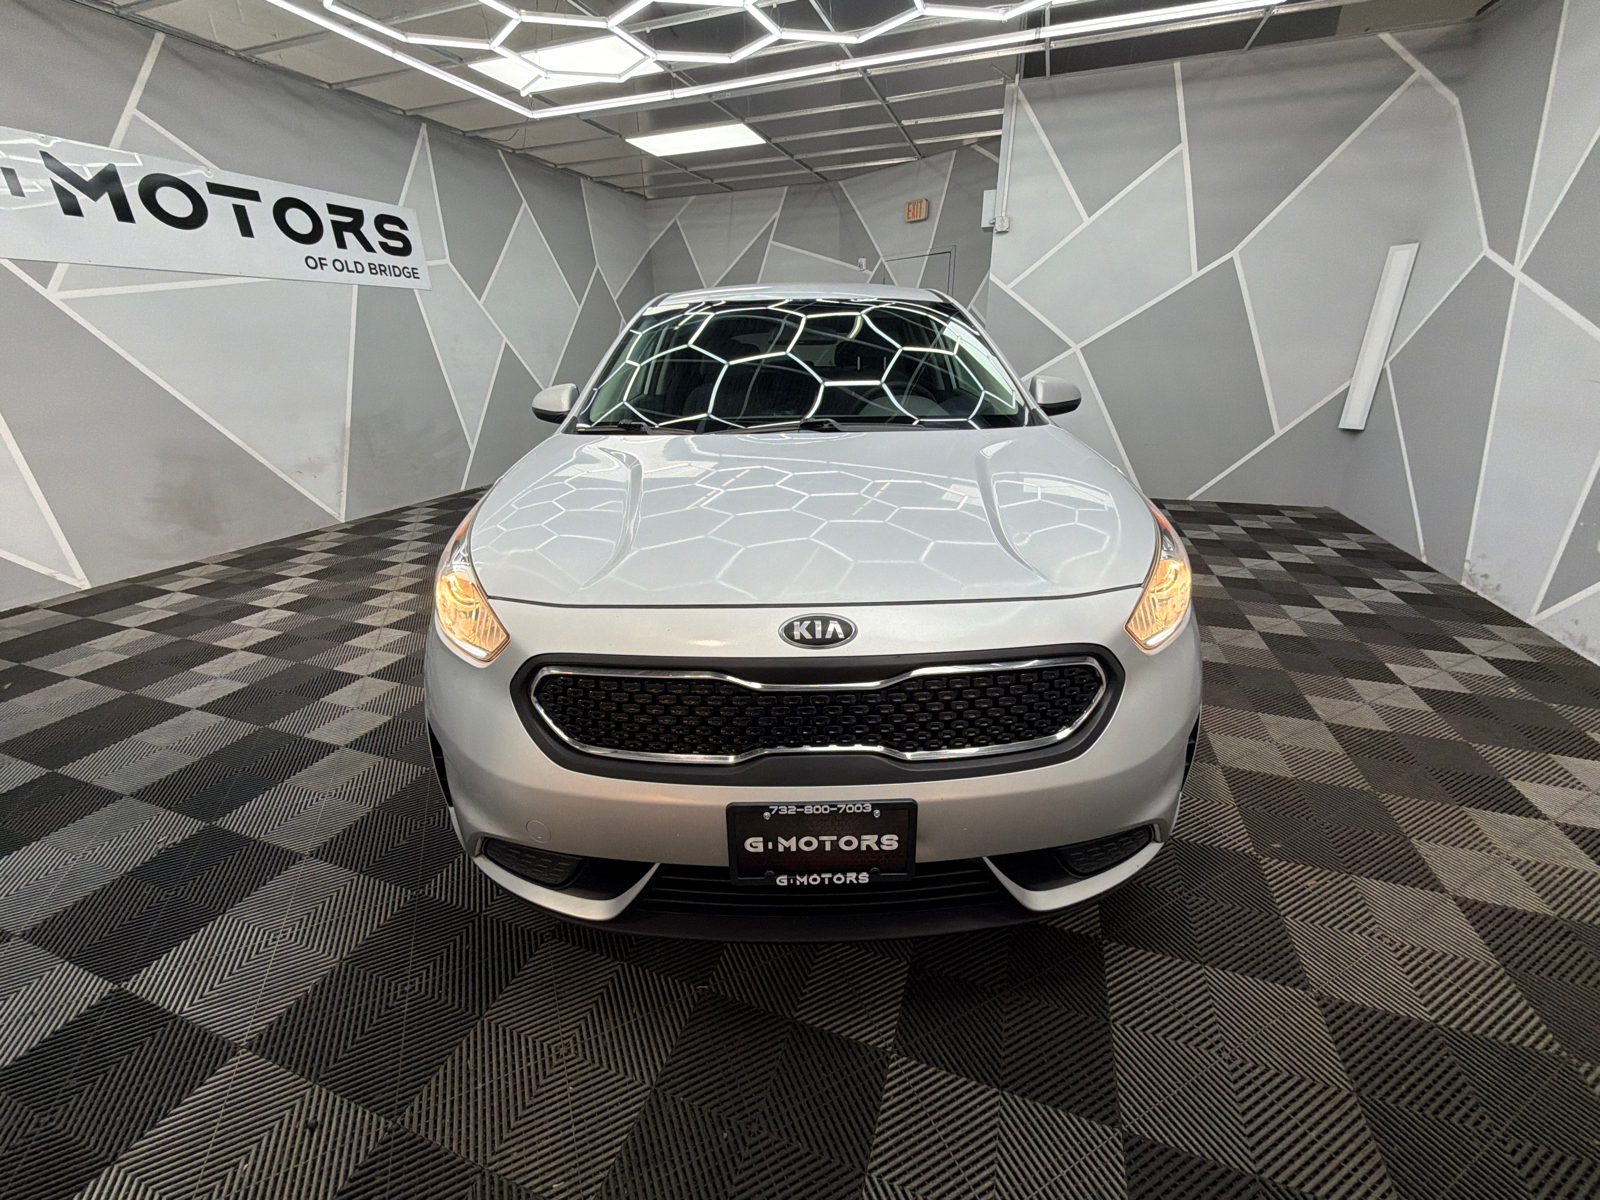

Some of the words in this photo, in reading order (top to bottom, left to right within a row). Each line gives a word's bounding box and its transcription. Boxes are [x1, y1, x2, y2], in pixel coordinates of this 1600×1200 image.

[39, 150, 413, 257] MOTORS
[907, 200, 924, 220] EXIT
[305, 256, 328, 271] OF
[332, 258, 365, 274] OLD
[368, 262, 421, 280] BRIDGE
[793, 620, 845, 640] KIA
[769, 803, 872, 815] 732-800-7003
